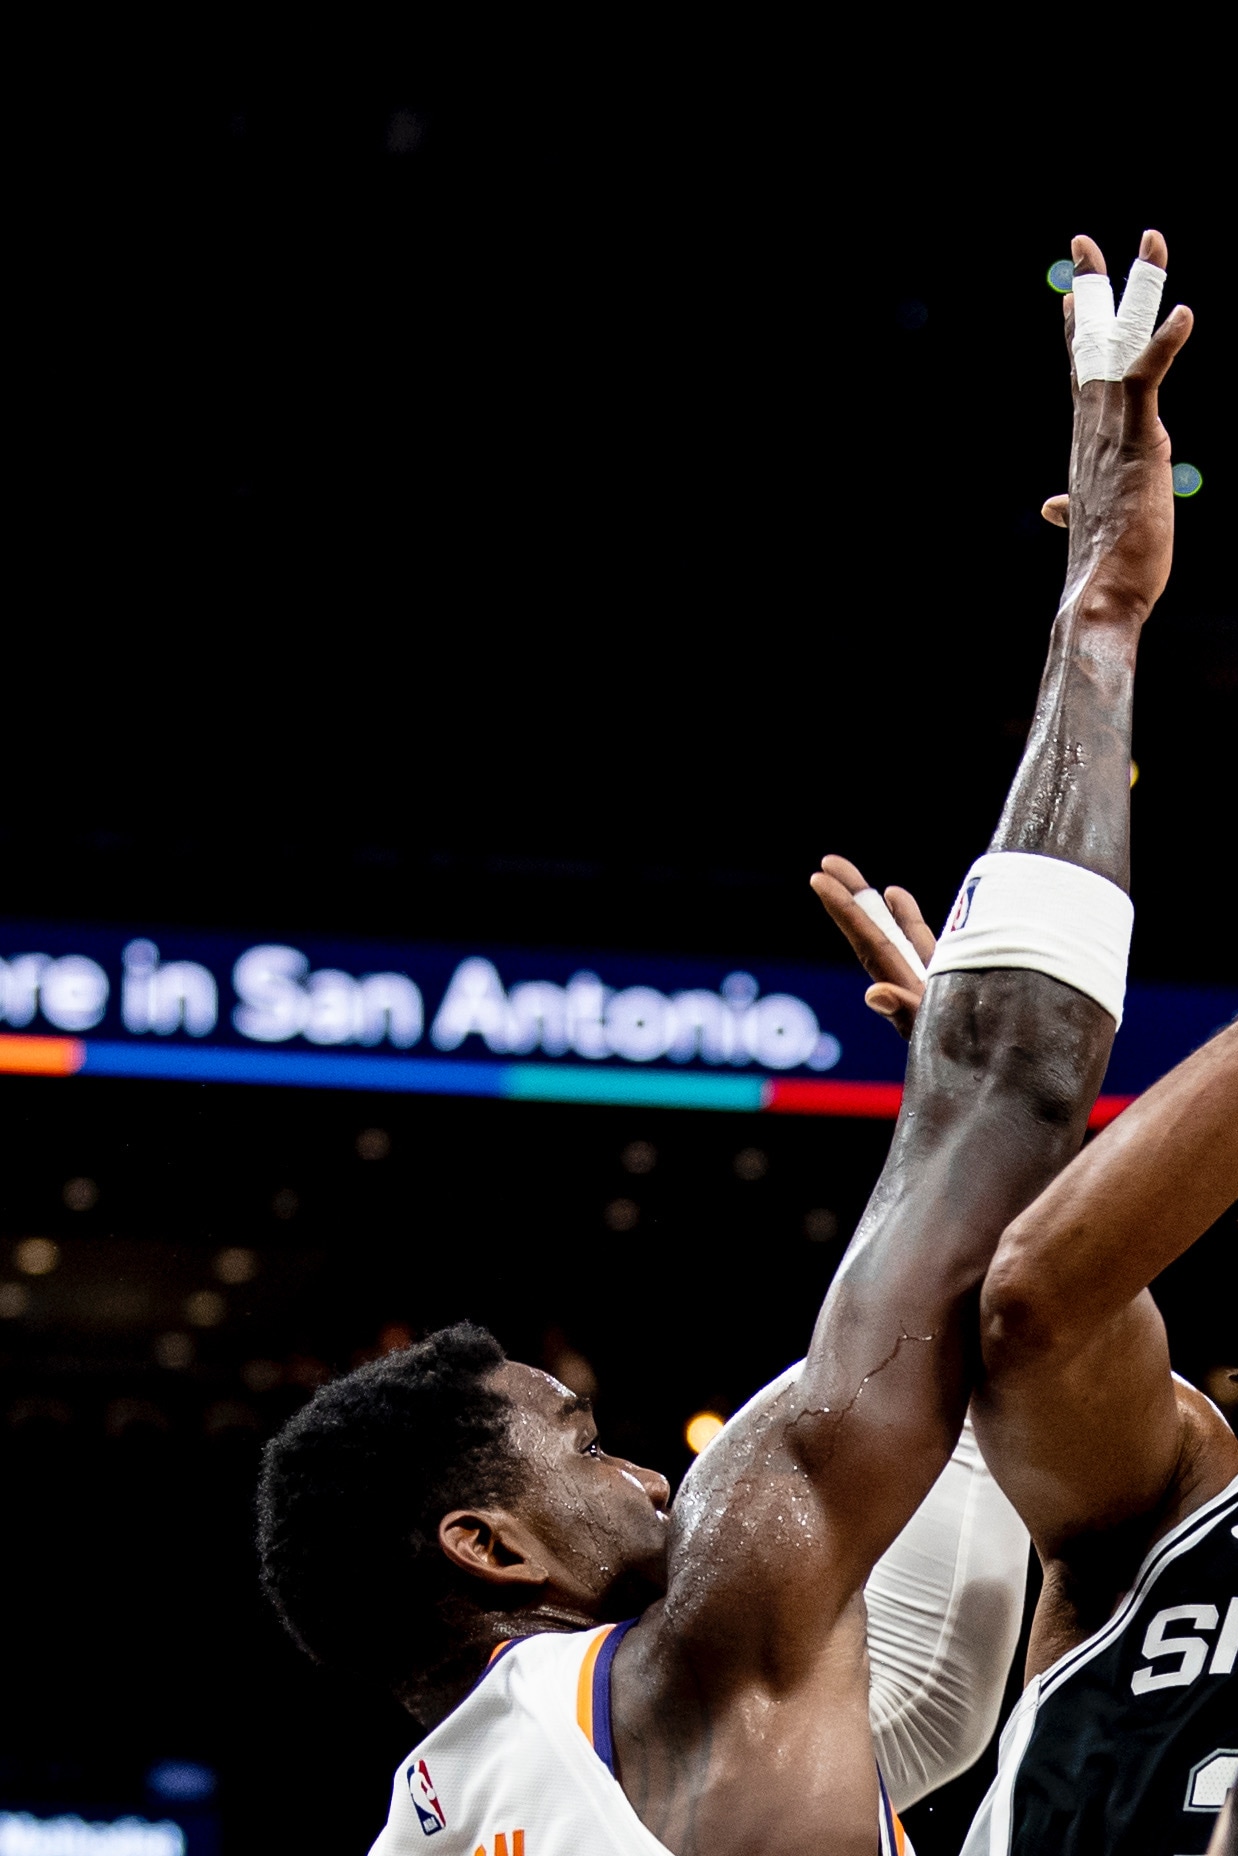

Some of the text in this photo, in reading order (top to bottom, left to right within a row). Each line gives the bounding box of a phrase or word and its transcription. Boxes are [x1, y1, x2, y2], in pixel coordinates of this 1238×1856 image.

[0, 938, 843, 1071] re in San Antonio.
